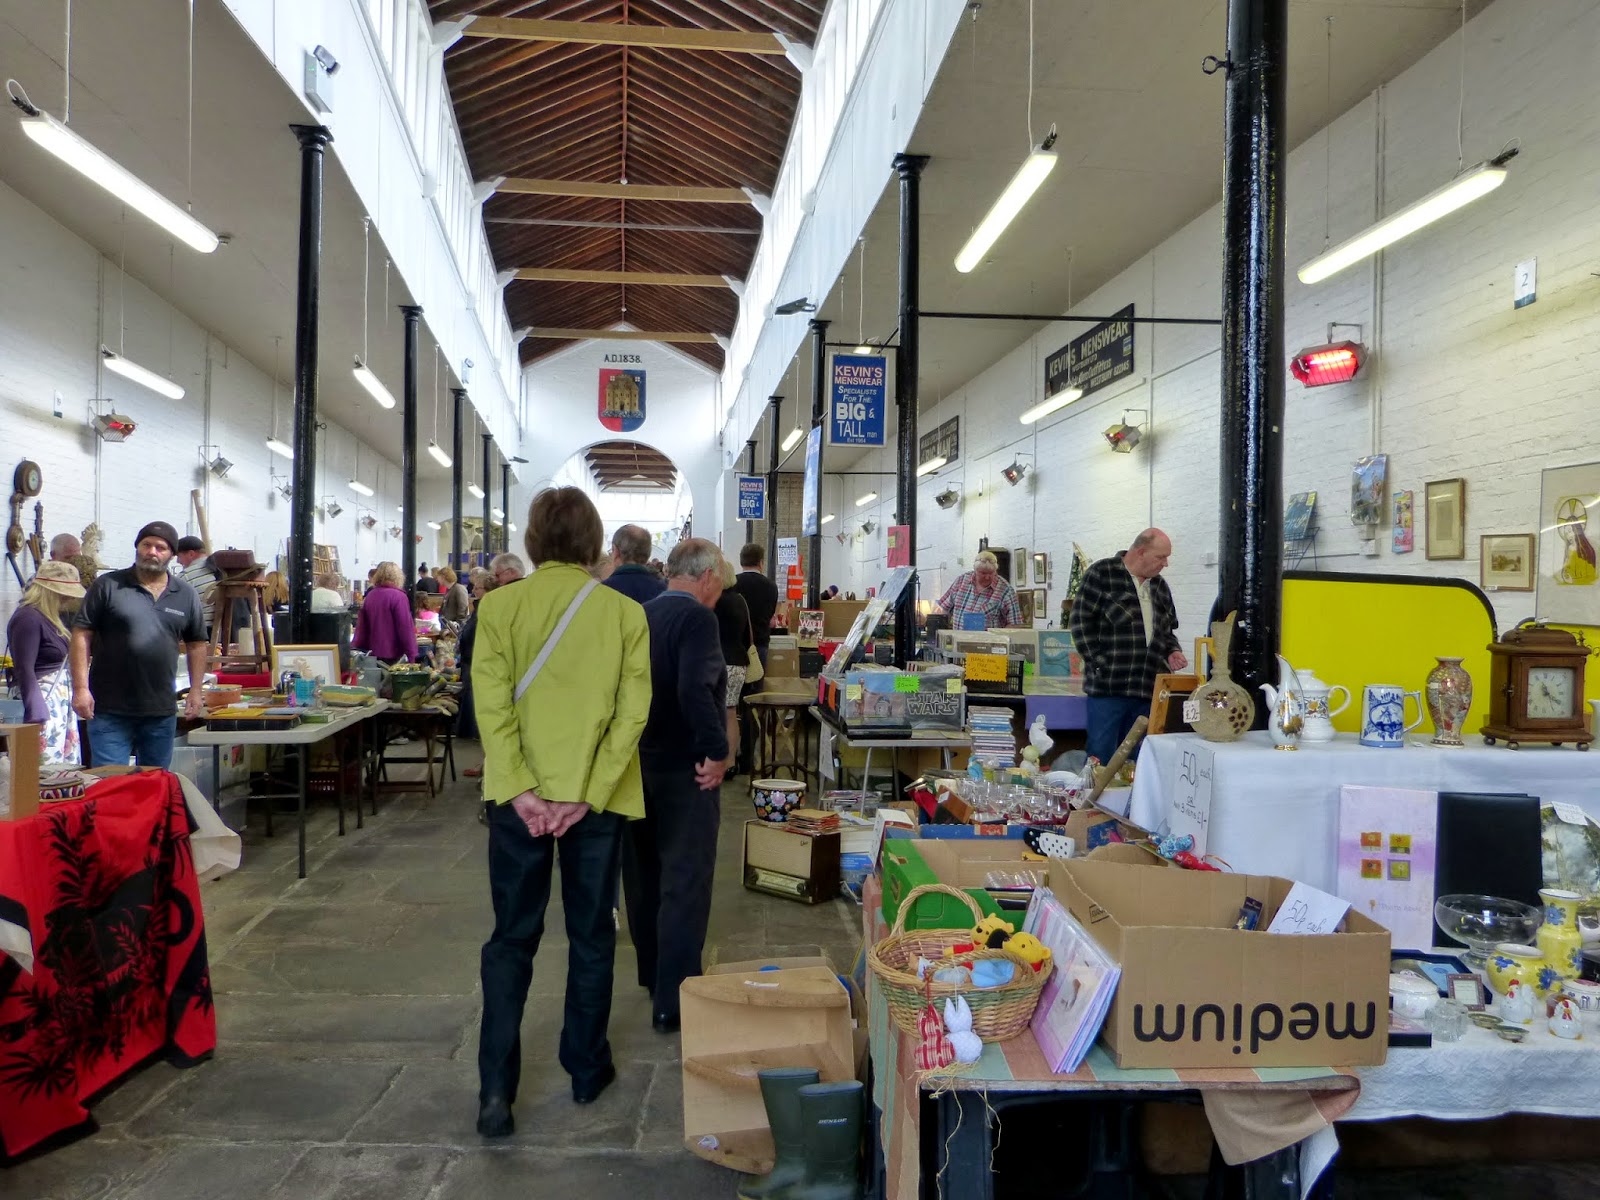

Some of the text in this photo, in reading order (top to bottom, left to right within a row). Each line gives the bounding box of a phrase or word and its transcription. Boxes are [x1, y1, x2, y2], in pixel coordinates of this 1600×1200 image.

[1521, 272, 1529, 287] 2
[1080, 321, 1129, 360] MENSWEAR
[835, 365, 882, 378] KEVIN'S
[834, 376, 882, 386] MENSWEAR
[836, 402, 875, 420] BIG &
[837, 420, 865, 437] TALL
[741, 499, 755, 508] BIG
[741, 507, 755, 515] TALL
[907, 691, 959, 704] STAR
[907, 702, 959, 715] WARS
[1133, 1001, 1376, 1055] medium
